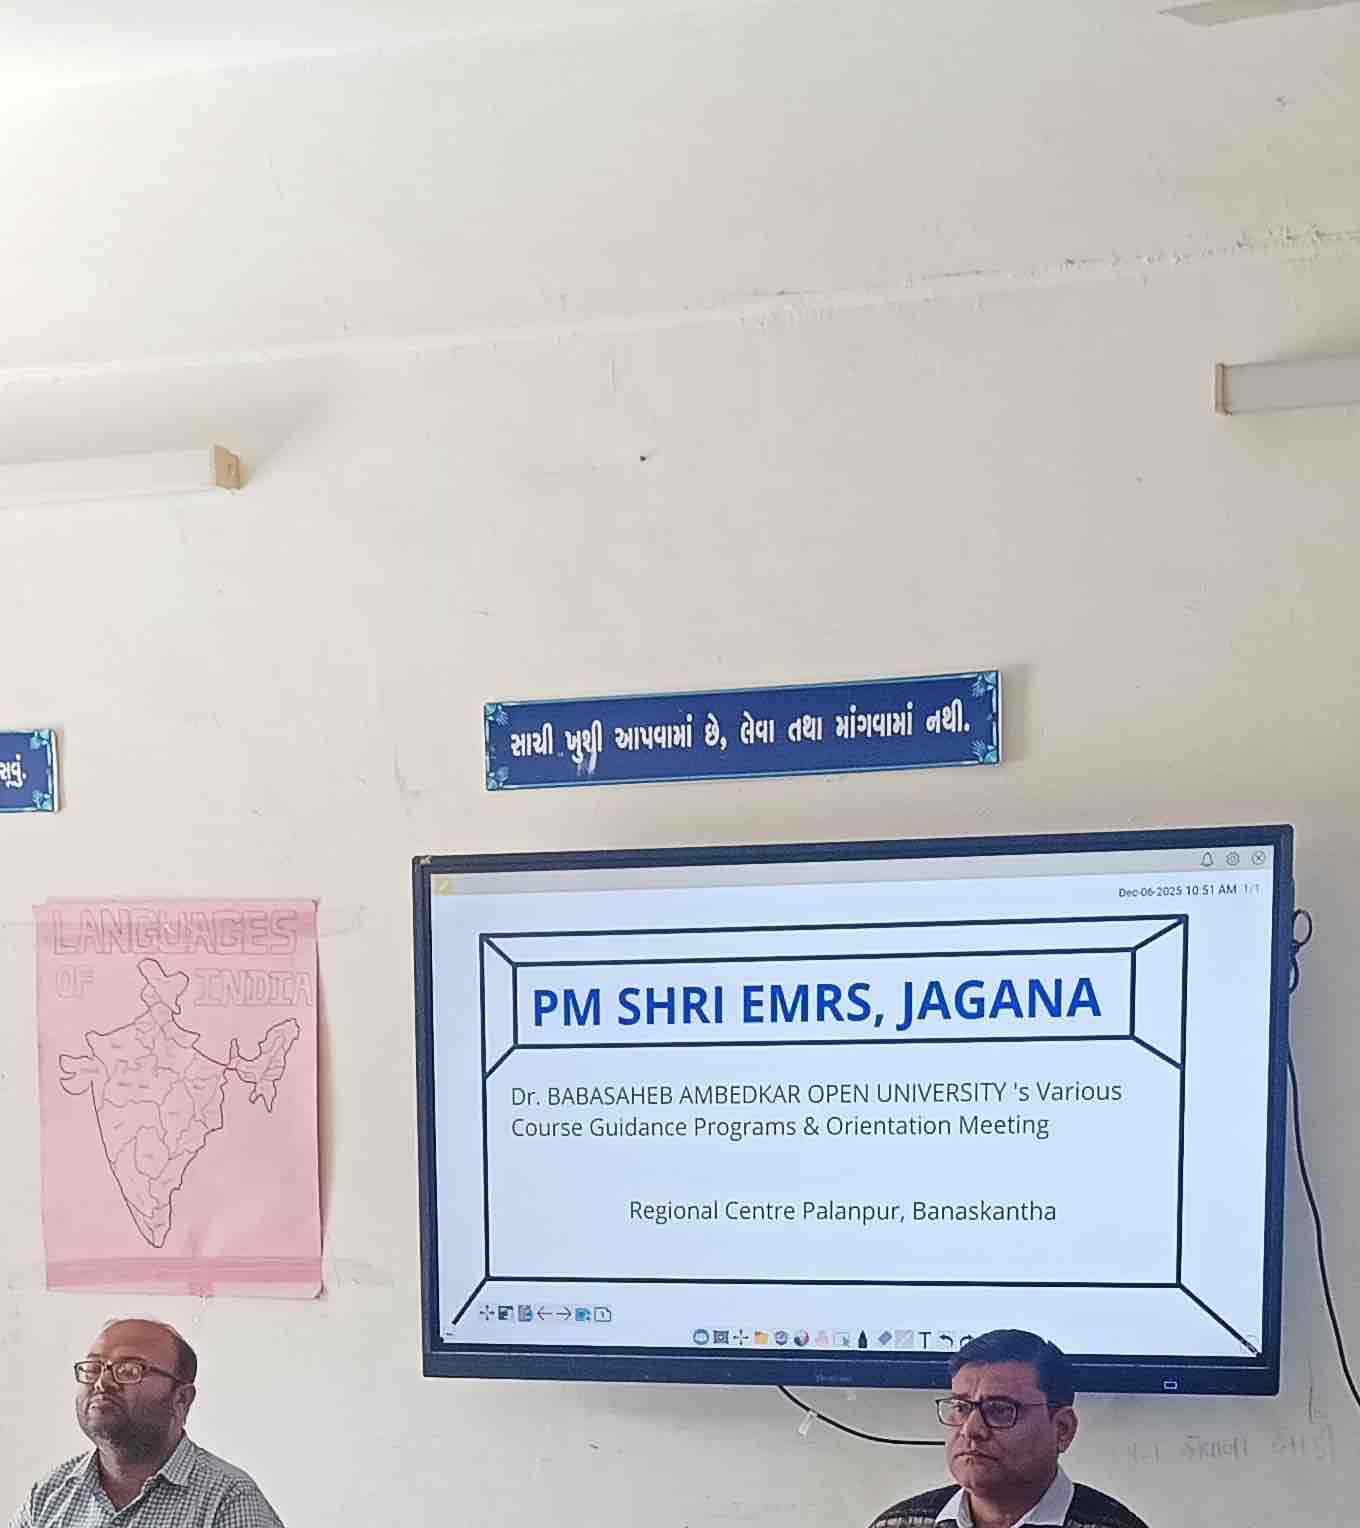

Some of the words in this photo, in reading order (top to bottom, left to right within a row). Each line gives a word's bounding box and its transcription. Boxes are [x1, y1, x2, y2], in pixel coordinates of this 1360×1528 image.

[510, 721, 553, 757] સાચી
[614, 712, 693, 751] આપવામાં
[704, 712, 728, 751] છે,
[740, 711, 775, 745] લેવા
[788, 714, 823, 742] તથા
[835, 700, 913, 739] માંગવામાં
[926, 698, 971, 735] નથી.
[1218, 884, 1237, 895] AM
[50, 906, 299, 956] LANGUAGES
[193, 968, 316, 1007] INDIA
[533, 987, 602, 1028] PM
[617, 984, 724, 1026] SHRI
[744, 980, 886, 1032] EMRS,
[895, 976, 1103, 1031] JAGANA
[511, 1087, 541, 1106] Dr.
[548, 1084, 674, 1106] BABASAHEB
[678, 1083, 802, 1105] AMBEDKAR
[807, 1083, 870, 1104] OPEN
[877, 1081, 1008, 1103] UNIVERSITY
[1035, 1080, 1123, 1102] Various
[511, 1117, 583, 1137] Course
[589, 1116, 687, 1137] Guidance
[694, 1116, 797, 1142] Programs
[803, 1116, 820, 1136] &
[826, 1114, 951, 1136] Orientation
[959, 1113, 1050, 1140] Meeting
[630, 1199, 718, 1226] Regional
[725, 1200, 796, 1221] Centre
[803, 1199, 905, 1227] Palanpur,
[913, 1199, 1057, 1222] Banaskantha
